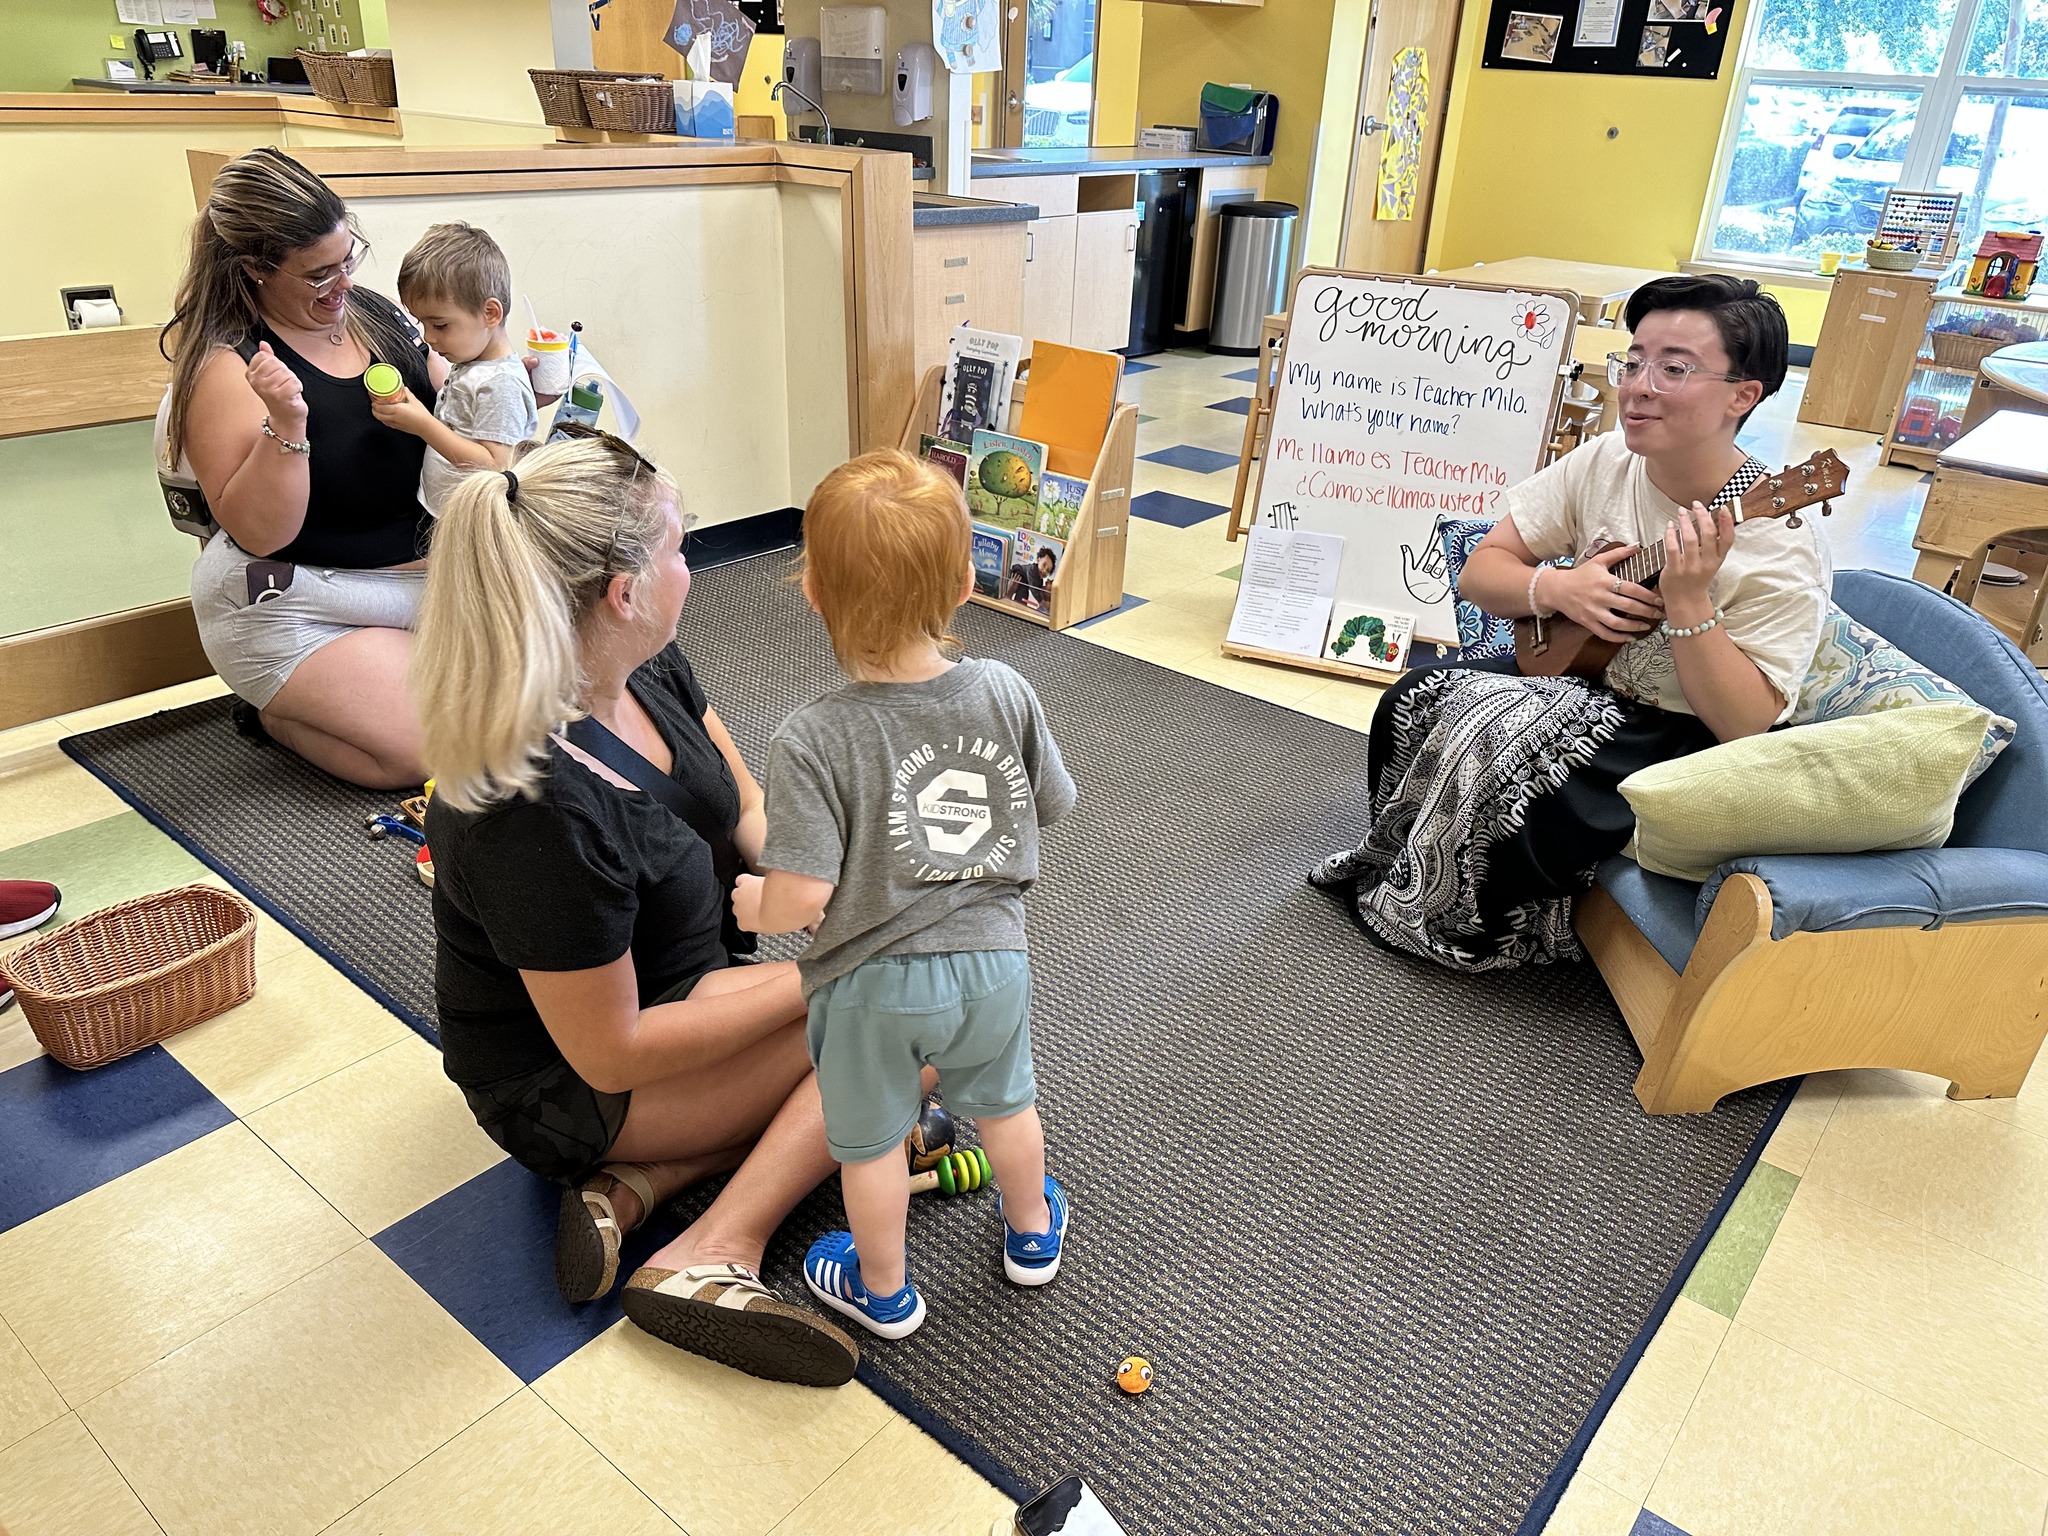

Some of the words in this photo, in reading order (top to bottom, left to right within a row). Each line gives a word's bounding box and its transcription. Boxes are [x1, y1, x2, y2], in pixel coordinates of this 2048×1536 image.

[1314, 286, 1439, 342] good
[1345, 320, 1532, 380] morning
[962, 364, 977, 374] OLLY
[977, 366, 988, 376] POP
[1289, 361, 1321, 393] My
[1333, 371, 1382, 395] name
[1391, 380, 1406, 396] is
[1413, 376, 1478, 408] Teacher
[1481, 387, 1527, 414] Milo.
[1302, 397, 1362, 422] What's
[1367, 407, 1404, 435] your
[1410, 414, 1461, 436] name?
[931, 451, 957, 464] HAROLD
[1011, 442, 1034, 462] Listen
[1277, 438, 1304, 461] Me
[1312, 443, 1365, 466] llamo
[1371, 451, 1391, 469] es
[1401, 451, 1469, 481] Teacher
[1065, 482, 1086, 496] JUST
[1387, 485, 1436, 510] llamas
[1440, 490, 1500, 515] usted?
[972, 536, 999, 552] Lullaby
[978, 548, 998, 560] Moon
[891, 743, 936, 804] STRONG
[957, 735, 964, 754] I
[969, 737, 1000, 762] AM
[996, 754, 1028, 810] BRAVE
[888, 811, 909, 836] AM
[922, 803, 987, 819] KIDSTRONG
[894, 840, 913, 851] I
[914, 863, 929, 878] I
[924, 869, 959, 881] CAN
[961, 864, 984, 880] DO
[984, 834, 1017, 873] THIS
